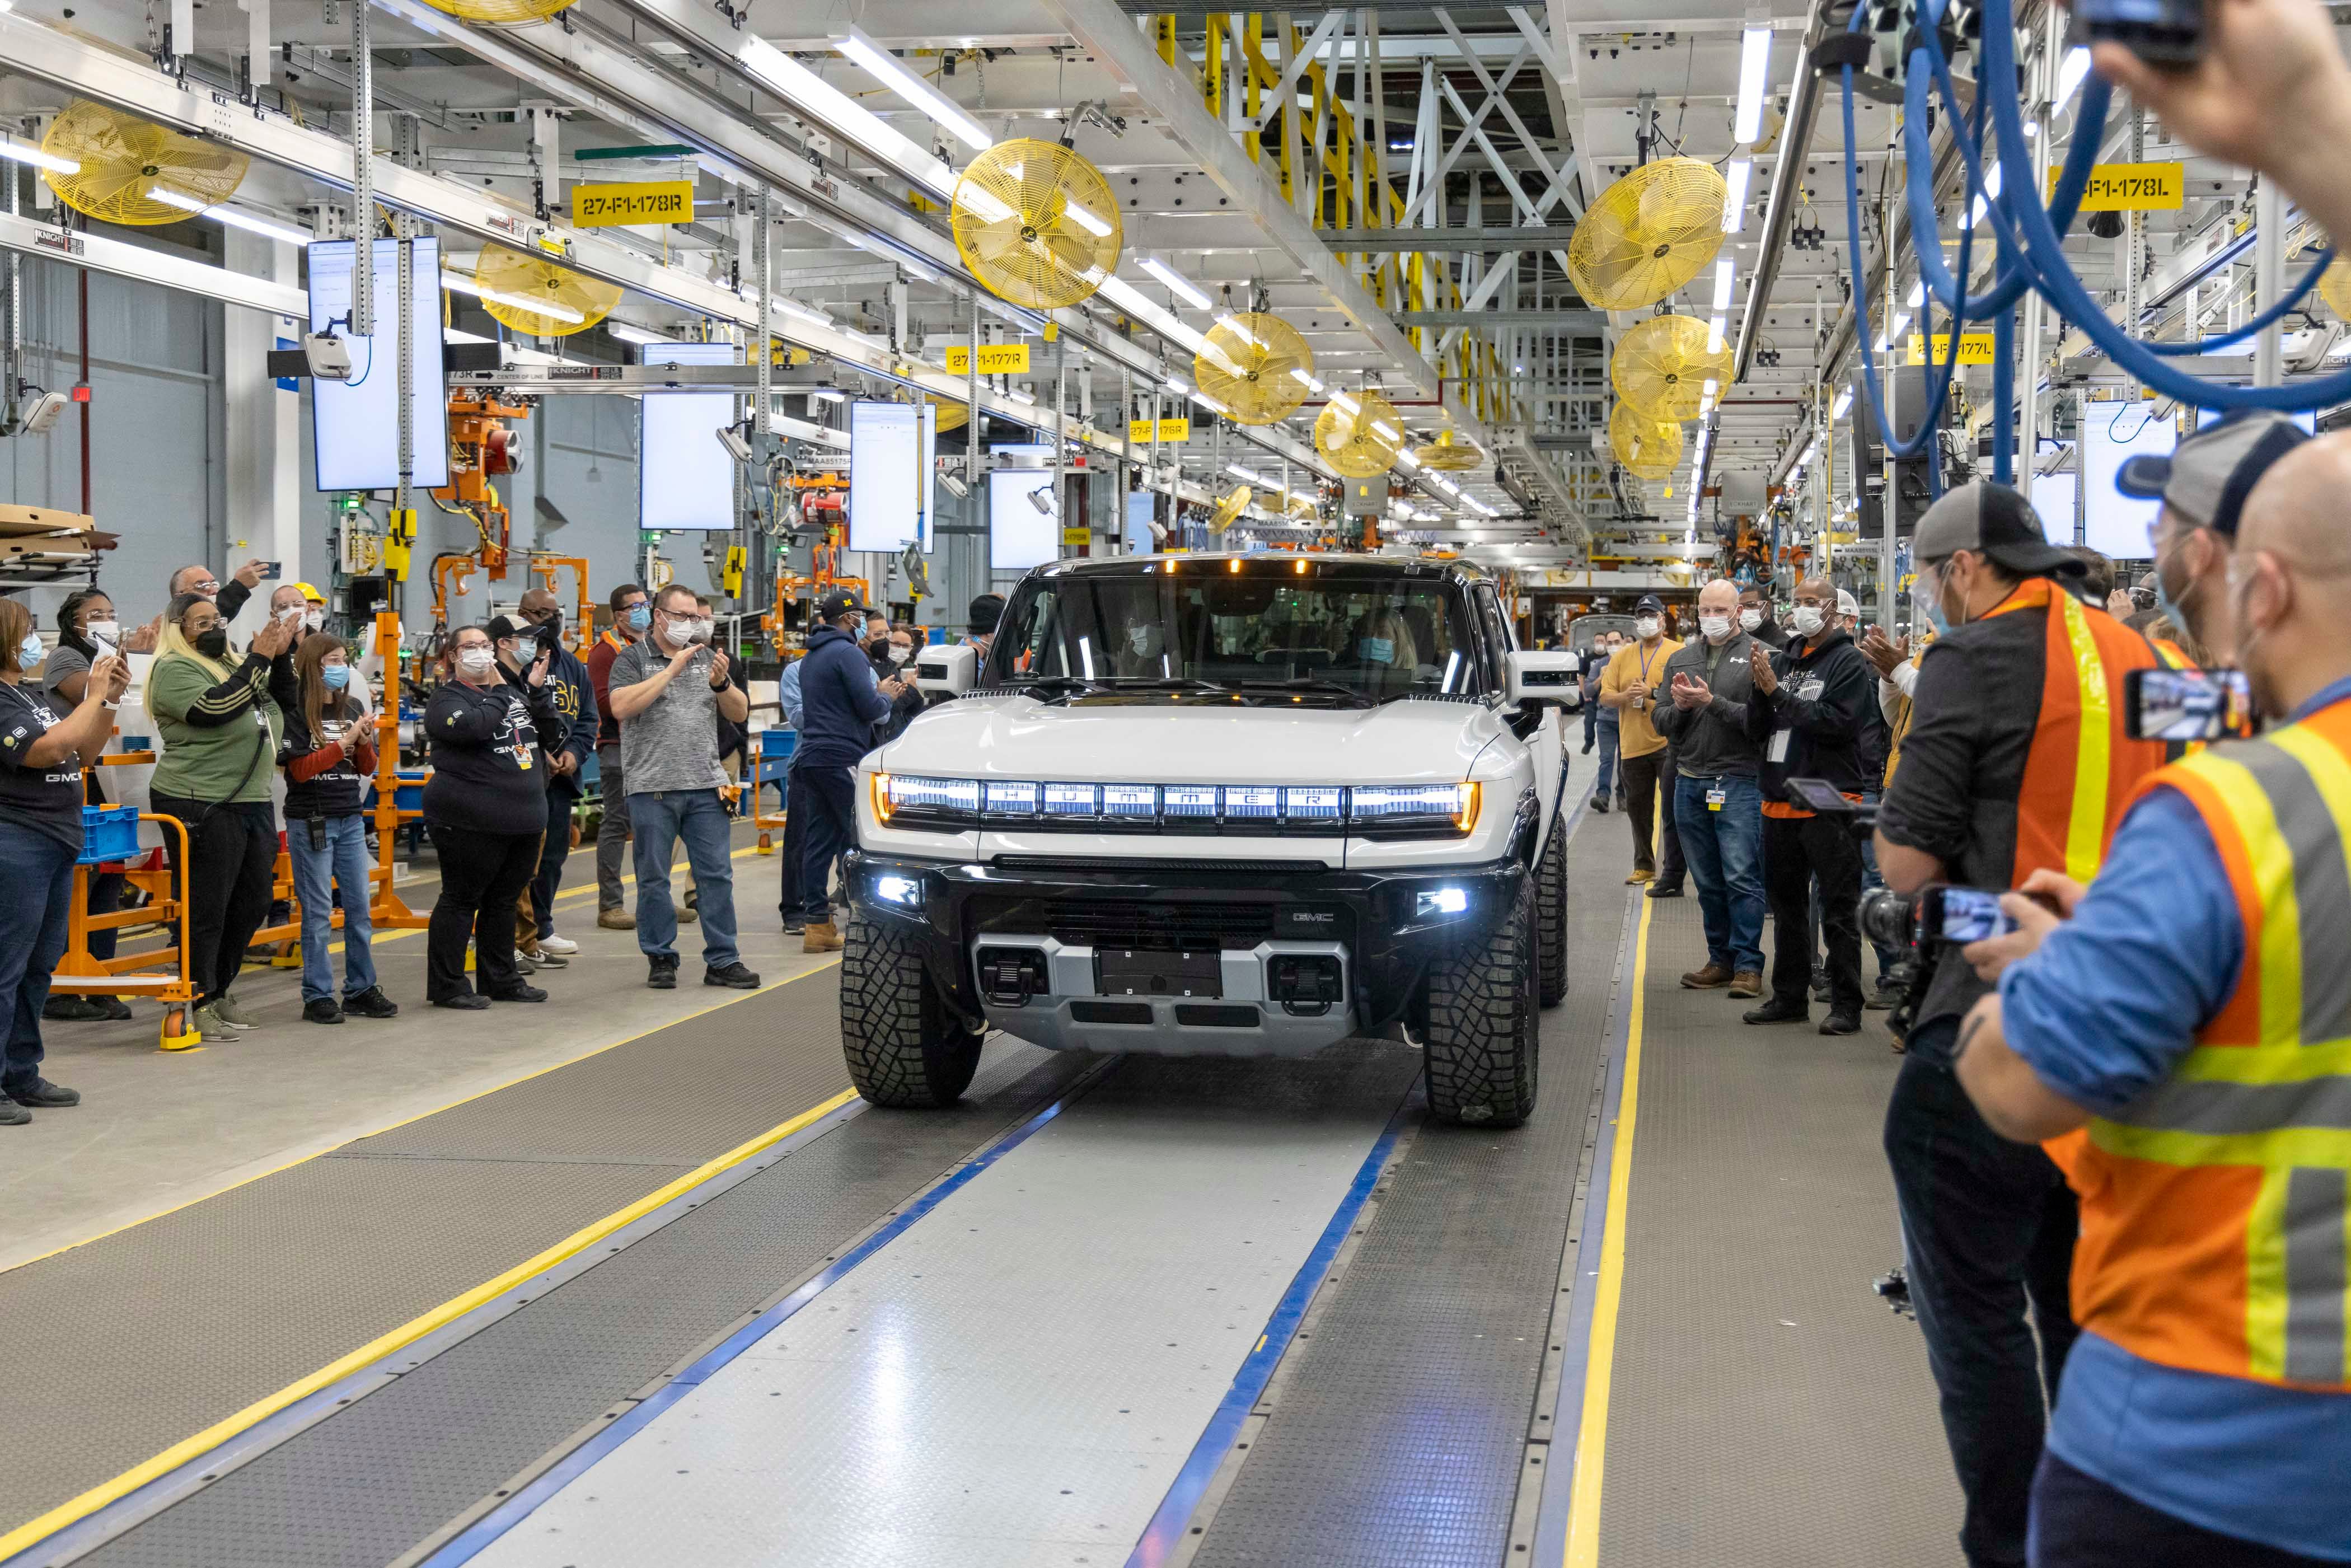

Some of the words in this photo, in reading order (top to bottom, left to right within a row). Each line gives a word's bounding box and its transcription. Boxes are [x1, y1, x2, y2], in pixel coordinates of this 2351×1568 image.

[2055, 179, 2169, 197] -F1-178L
[584, 194, 681, 215] 27-F1-178R
[38, 230, 65, 244] KNIGHT
[954, 354, 1020, 366] 271-177R
[1131, 426, 1182, 436] 27-F176R
[493, 745, 516, 753] GM
[1005, 790, 1320, 805] HUMMER
[1294, 913, 1333, 922] GMC
